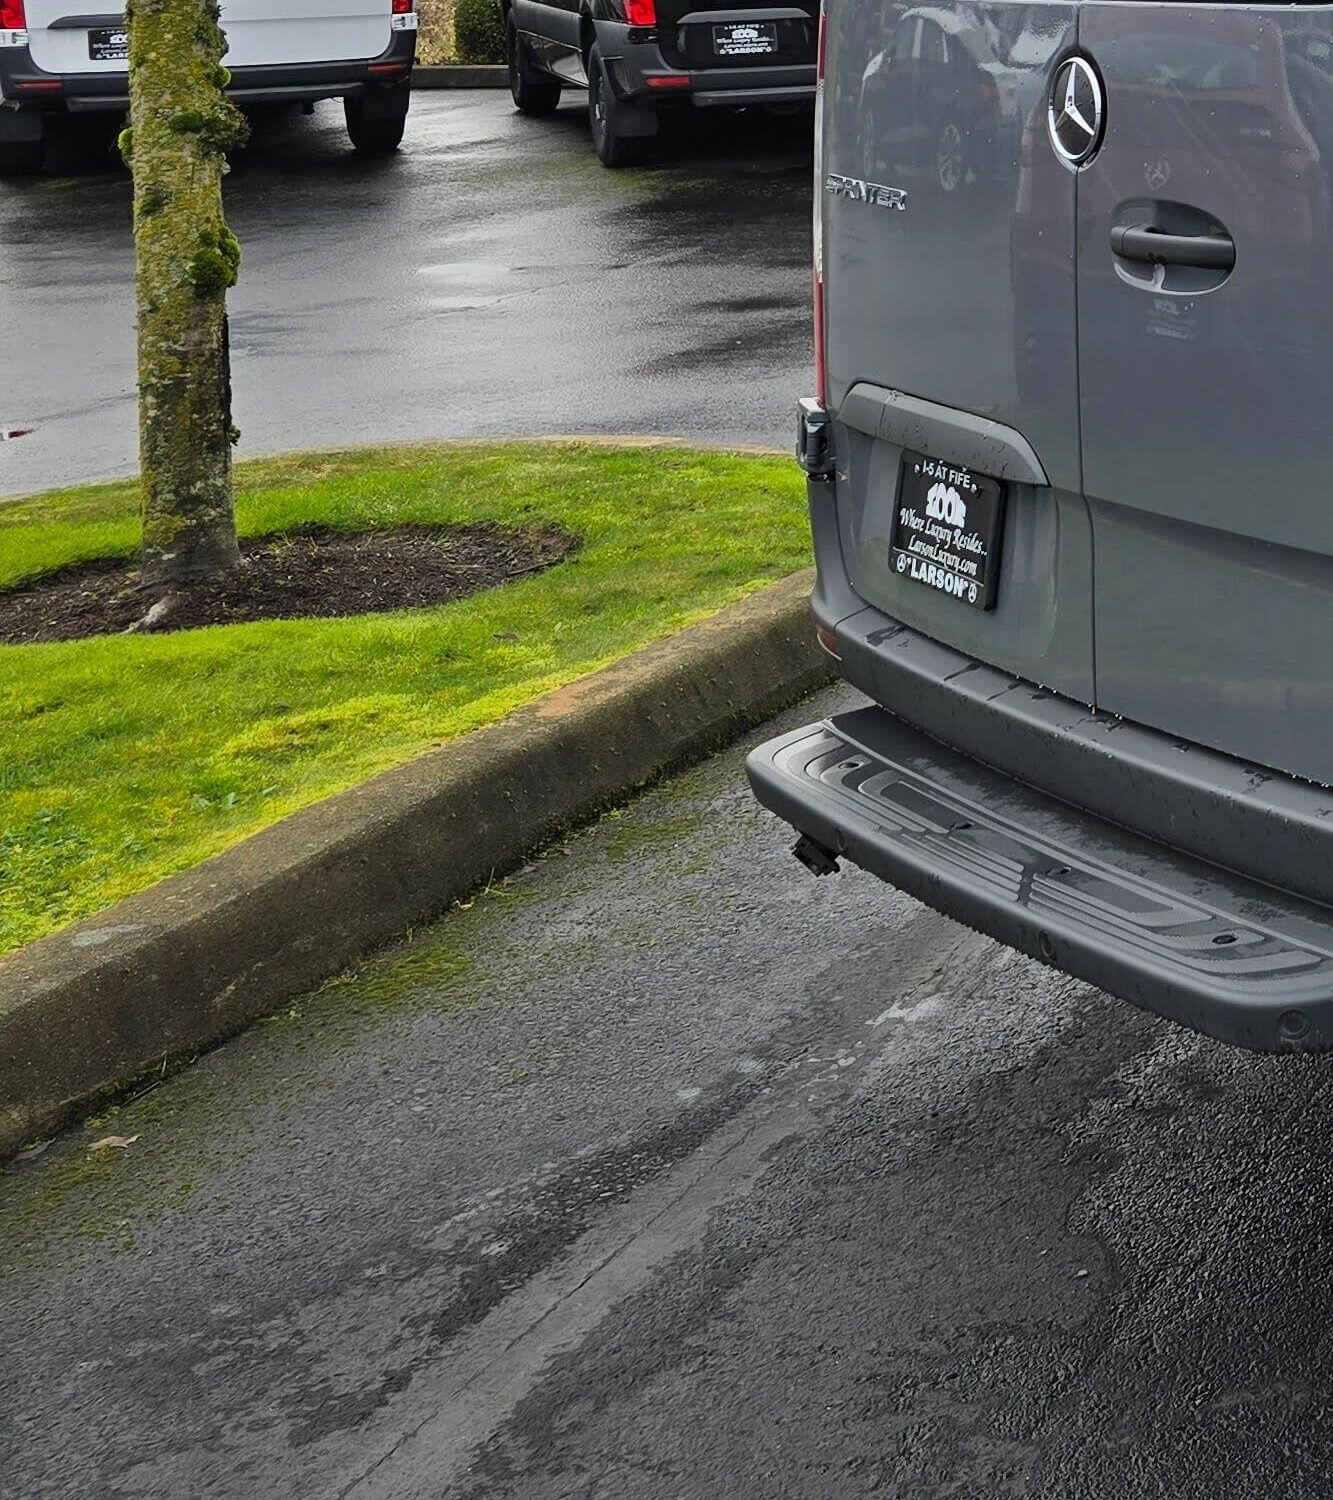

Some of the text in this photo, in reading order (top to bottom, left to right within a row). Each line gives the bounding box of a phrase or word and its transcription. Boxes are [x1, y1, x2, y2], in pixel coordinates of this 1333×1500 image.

[935, 465, 948, 480] AT
[949, 469, 971, 489] FIFE
[900, 507, 925, 532] Where
[926, 518, 952, 549] Luxury
[908, 534, 978, 577] LarsonLuxury.com
